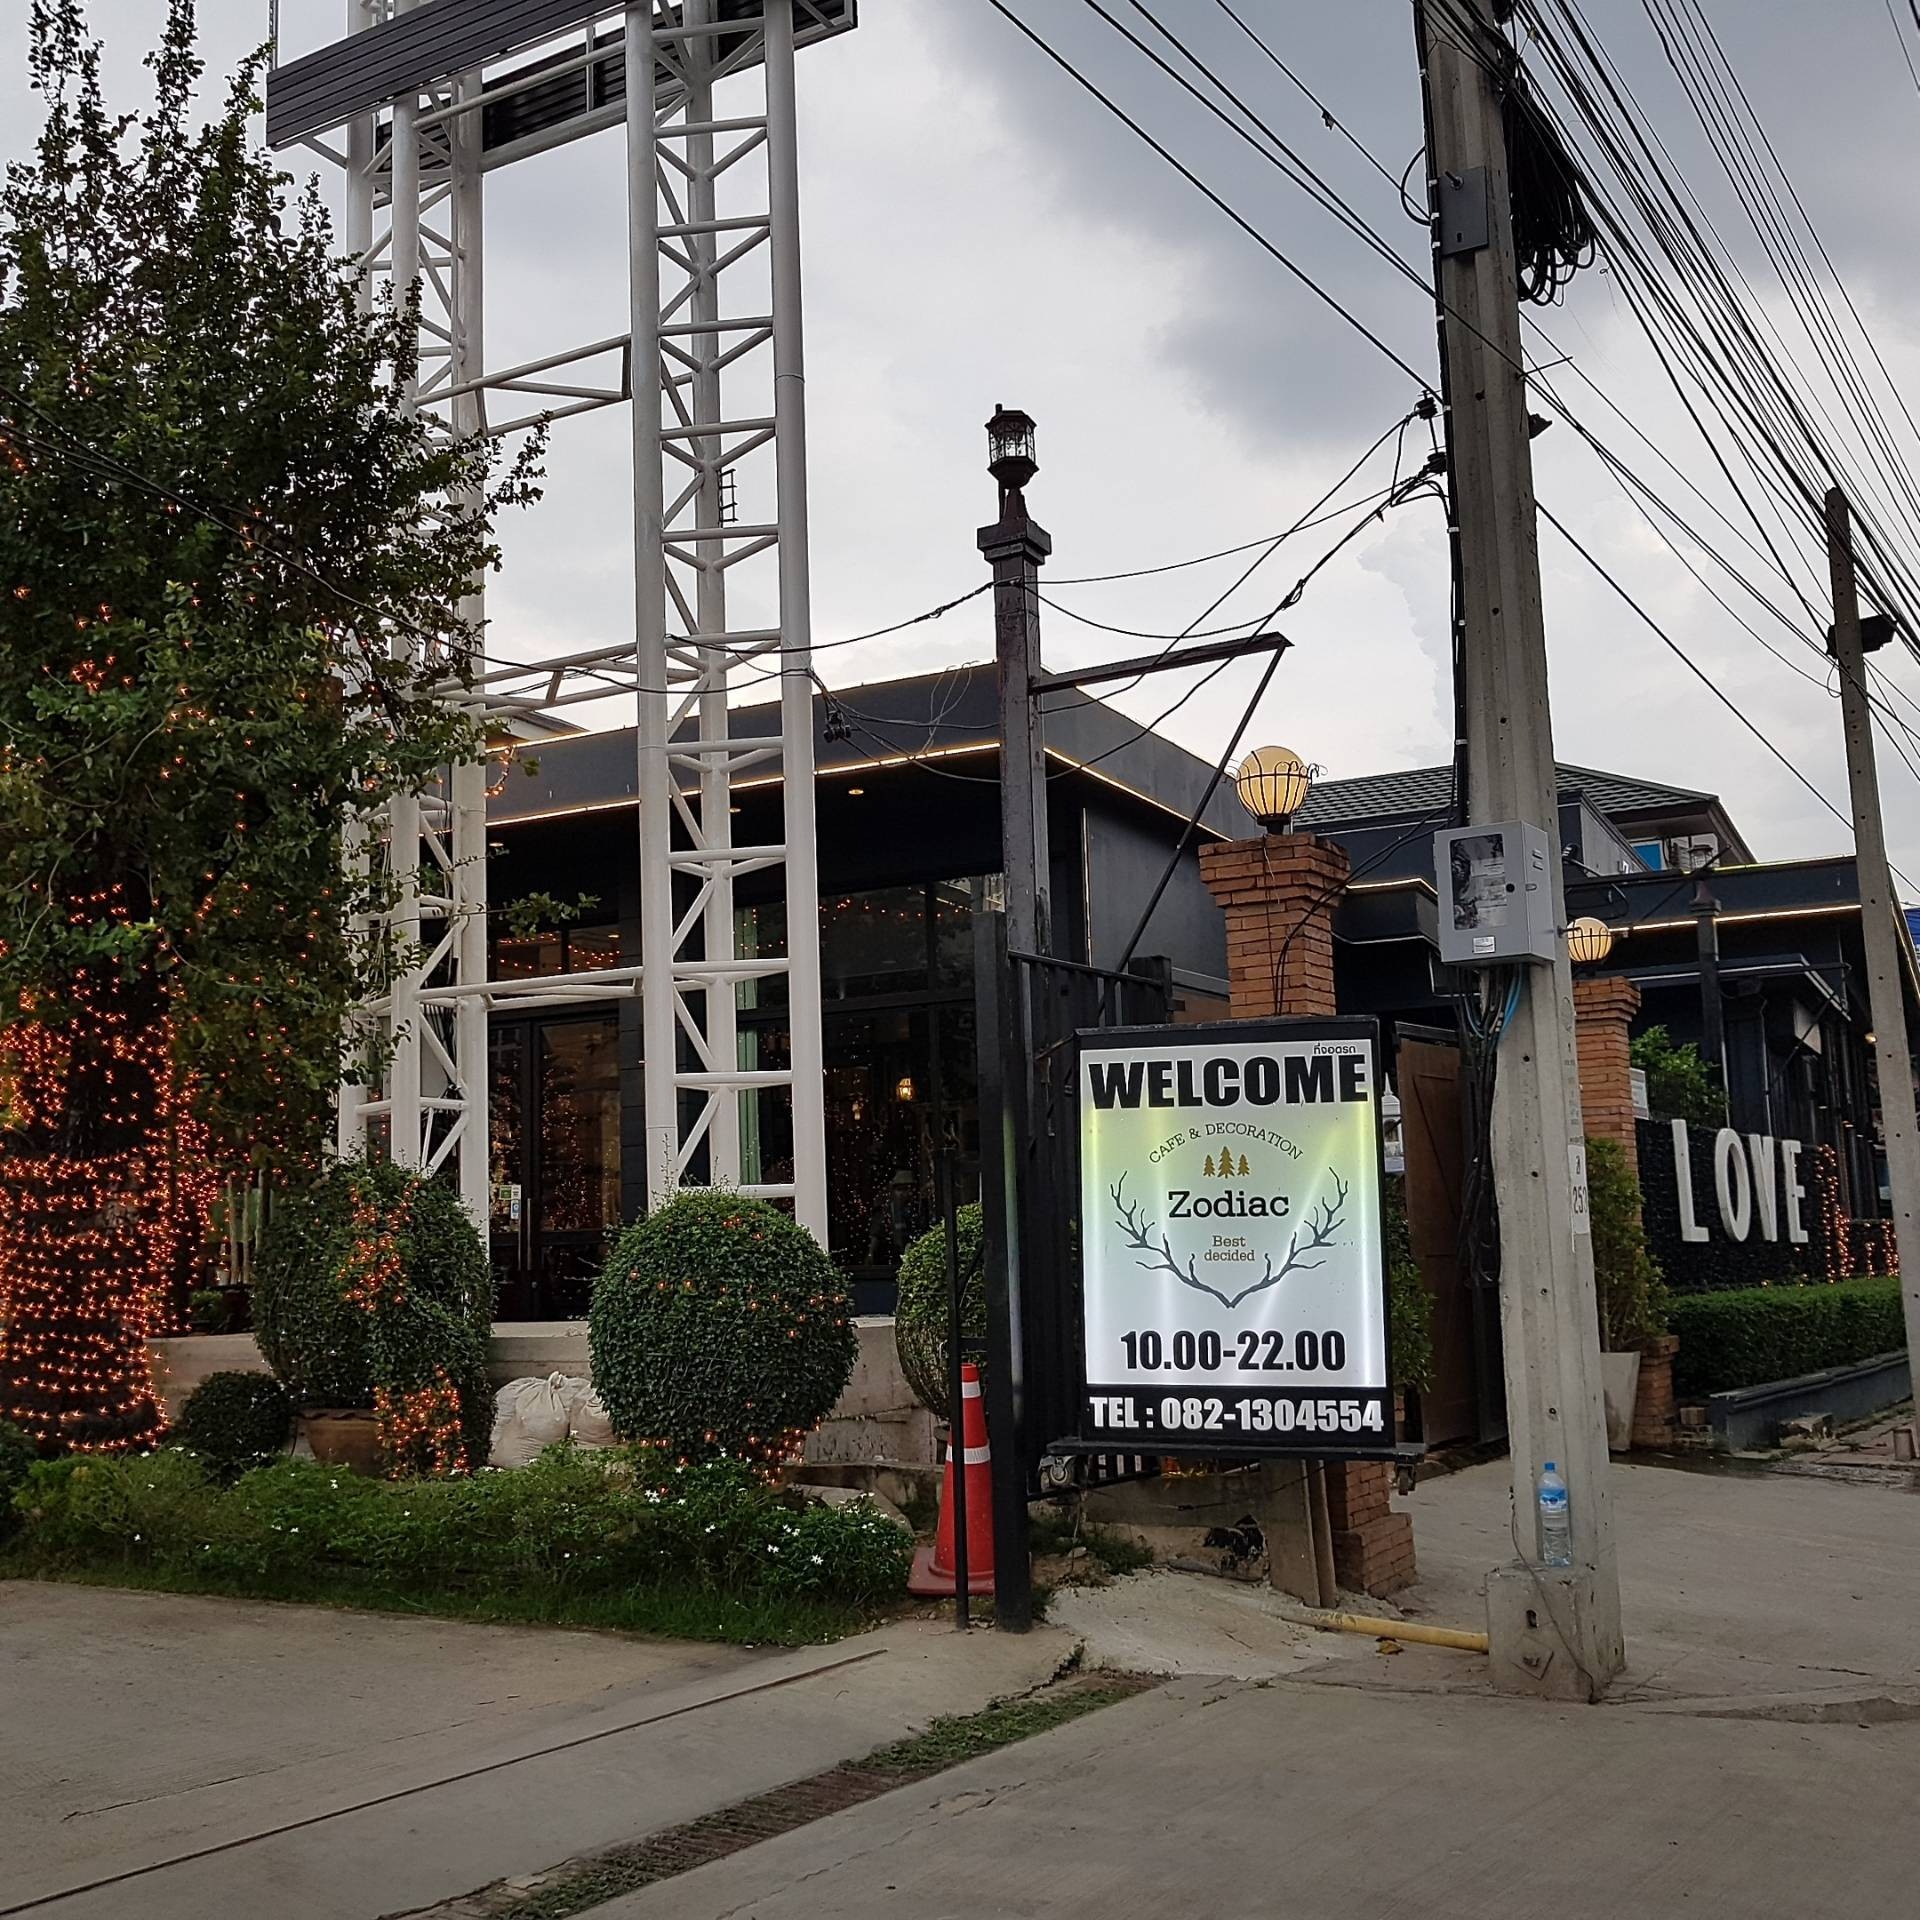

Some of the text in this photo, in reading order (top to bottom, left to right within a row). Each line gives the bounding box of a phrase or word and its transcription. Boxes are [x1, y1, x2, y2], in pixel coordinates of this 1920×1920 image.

[1088, 1054, 1369, 1109] WELCOME
[1149, 1122, 1304, 1163] CAFE & DECORATION
[1671, 1119, 1809, 1243] LOVE
[1168, 1190, 1290, 1218] Zodiac
[1204, 1249, 1255, 1261] decided
[1212, 1235, 1246, 1247] Best
[1120, 1330, 1346, 1371] 10.00-22.00
[1161, 1397, 1384, 1432] 082-1304554
